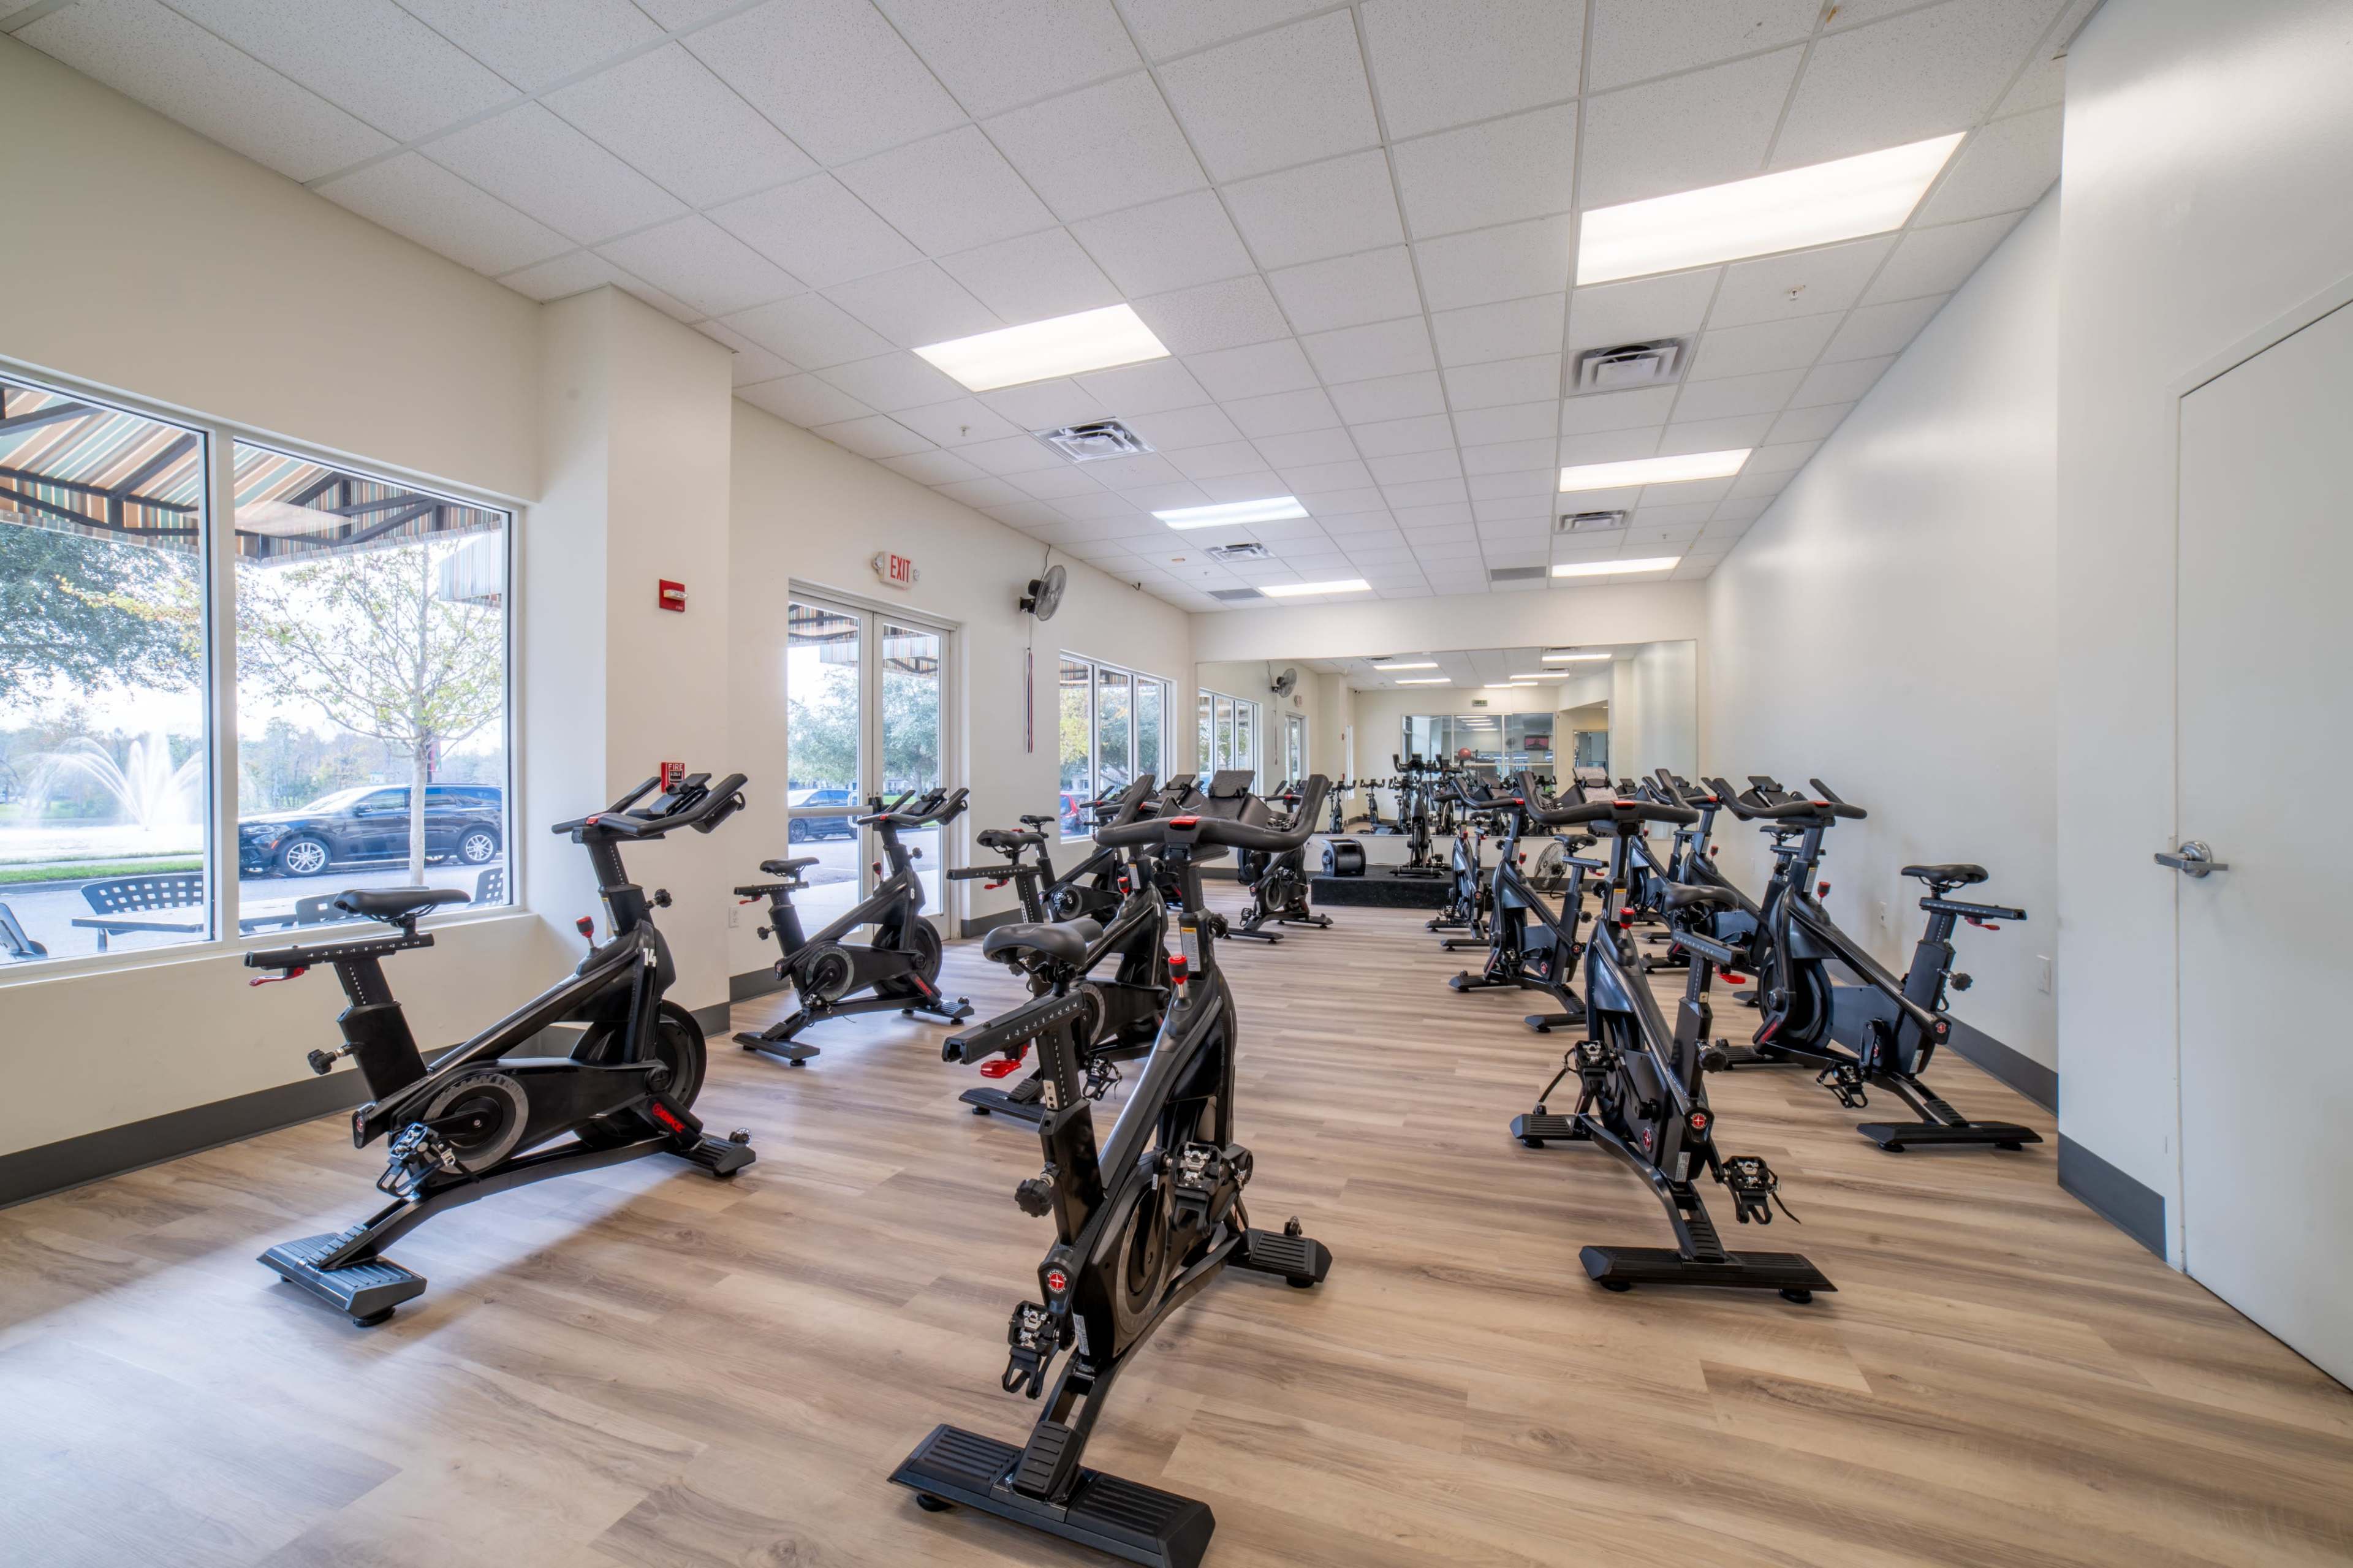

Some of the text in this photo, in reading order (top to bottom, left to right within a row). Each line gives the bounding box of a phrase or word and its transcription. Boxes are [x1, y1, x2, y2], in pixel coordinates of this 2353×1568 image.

[890, 554, 911, 583] EXIT
[910, 888, 915, 899] 6
[643, 947, 657, 968] 14
